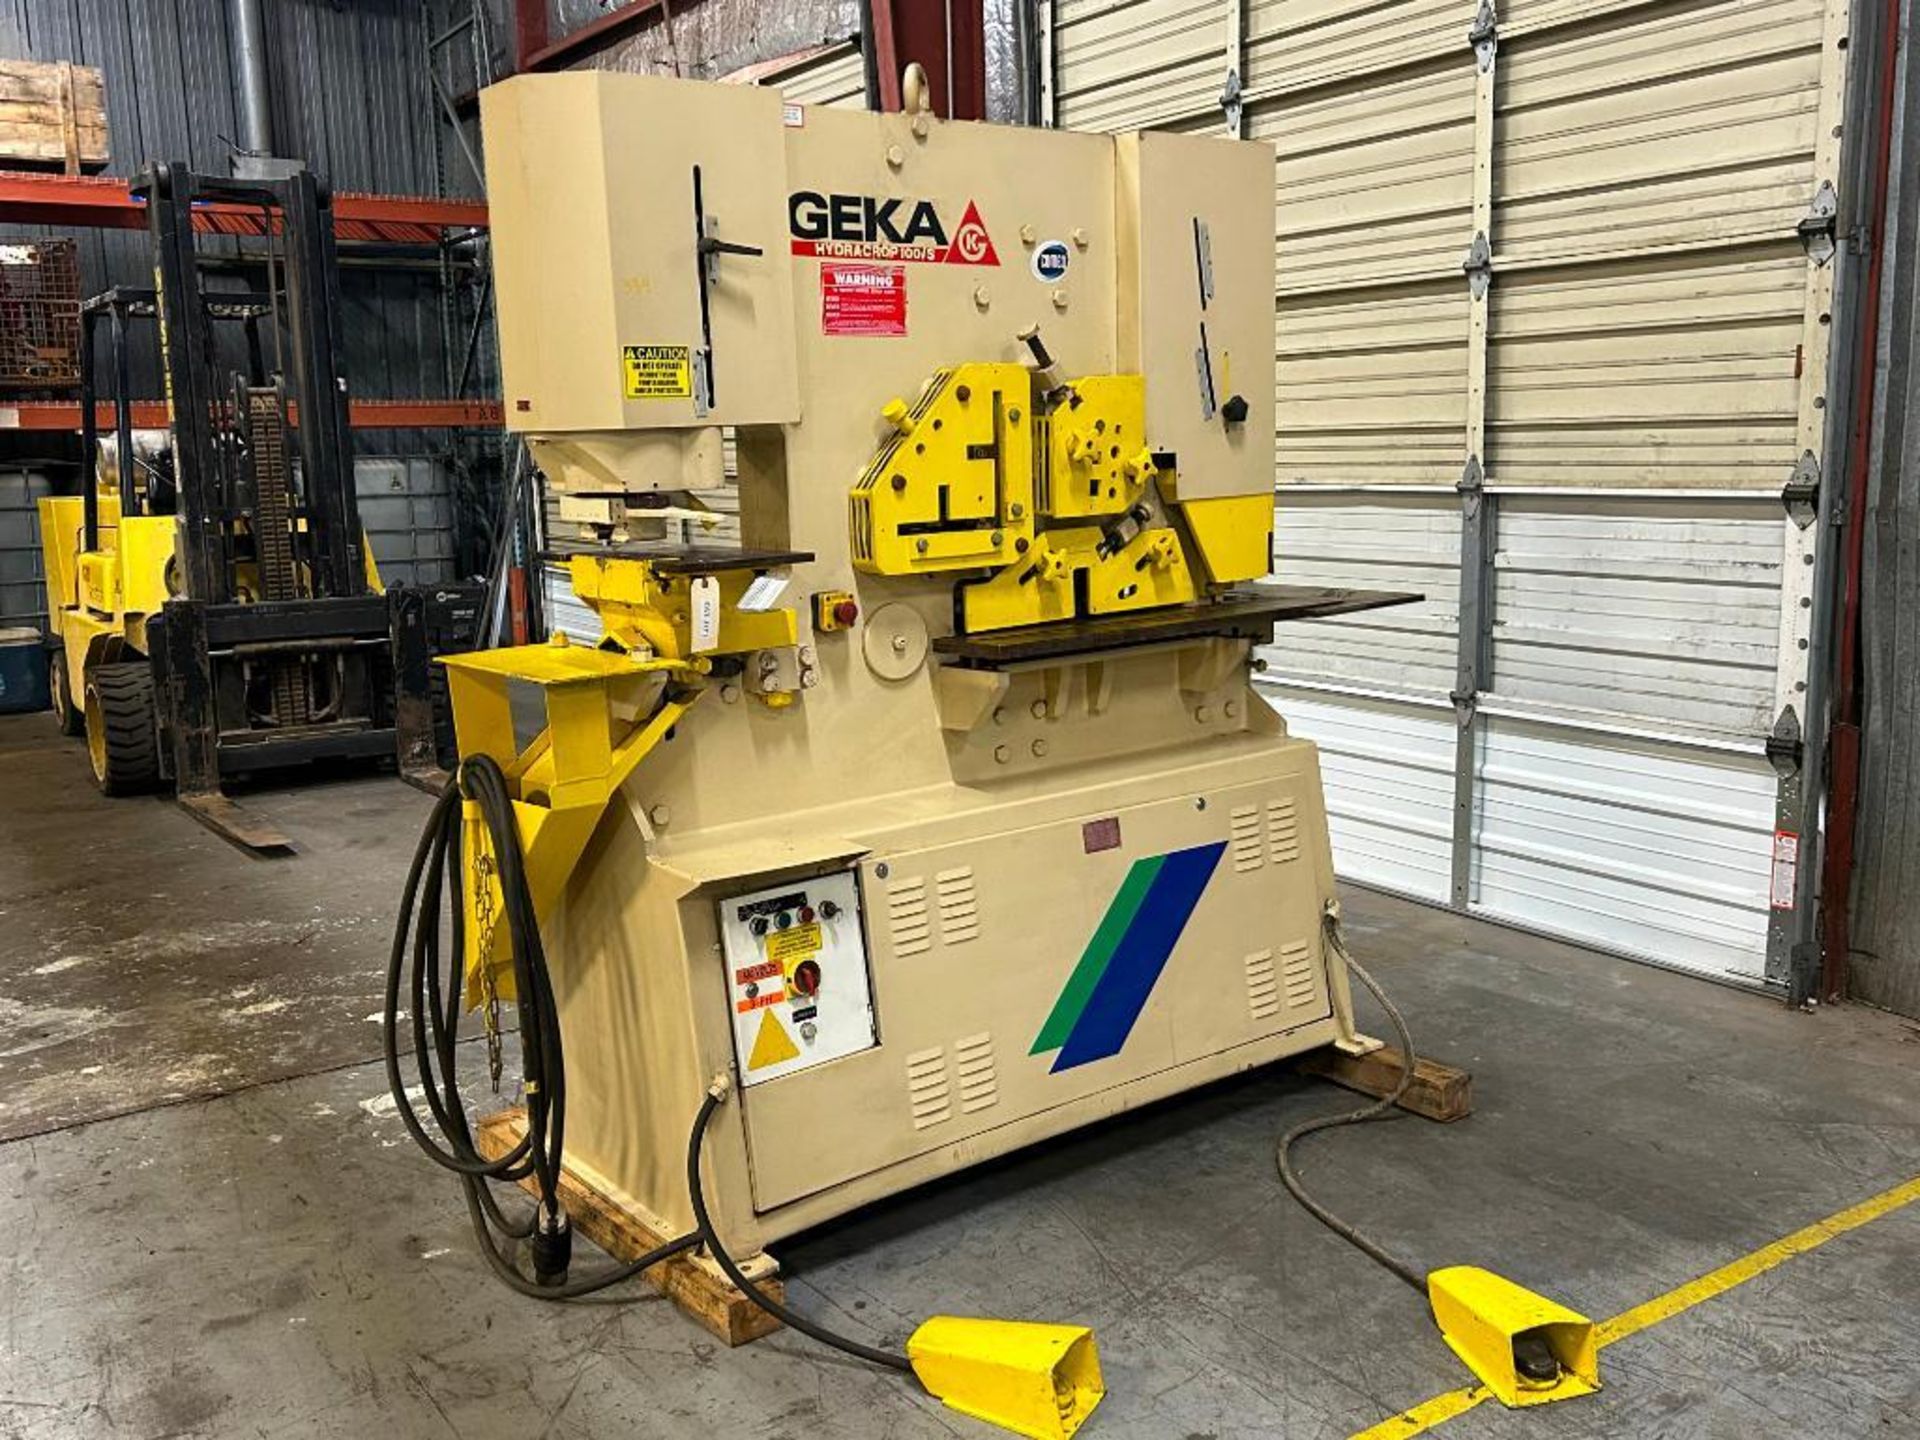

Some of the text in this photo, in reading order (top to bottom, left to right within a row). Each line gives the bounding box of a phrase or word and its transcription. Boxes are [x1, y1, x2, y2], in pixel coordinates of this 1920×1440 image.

[788, 191, 949, 246] GEKA
[815, 242, 898, 260] HYDRACROP
[833, 271, 895, 288] WARNING
[636, 347, 687, 360] CAUTION
